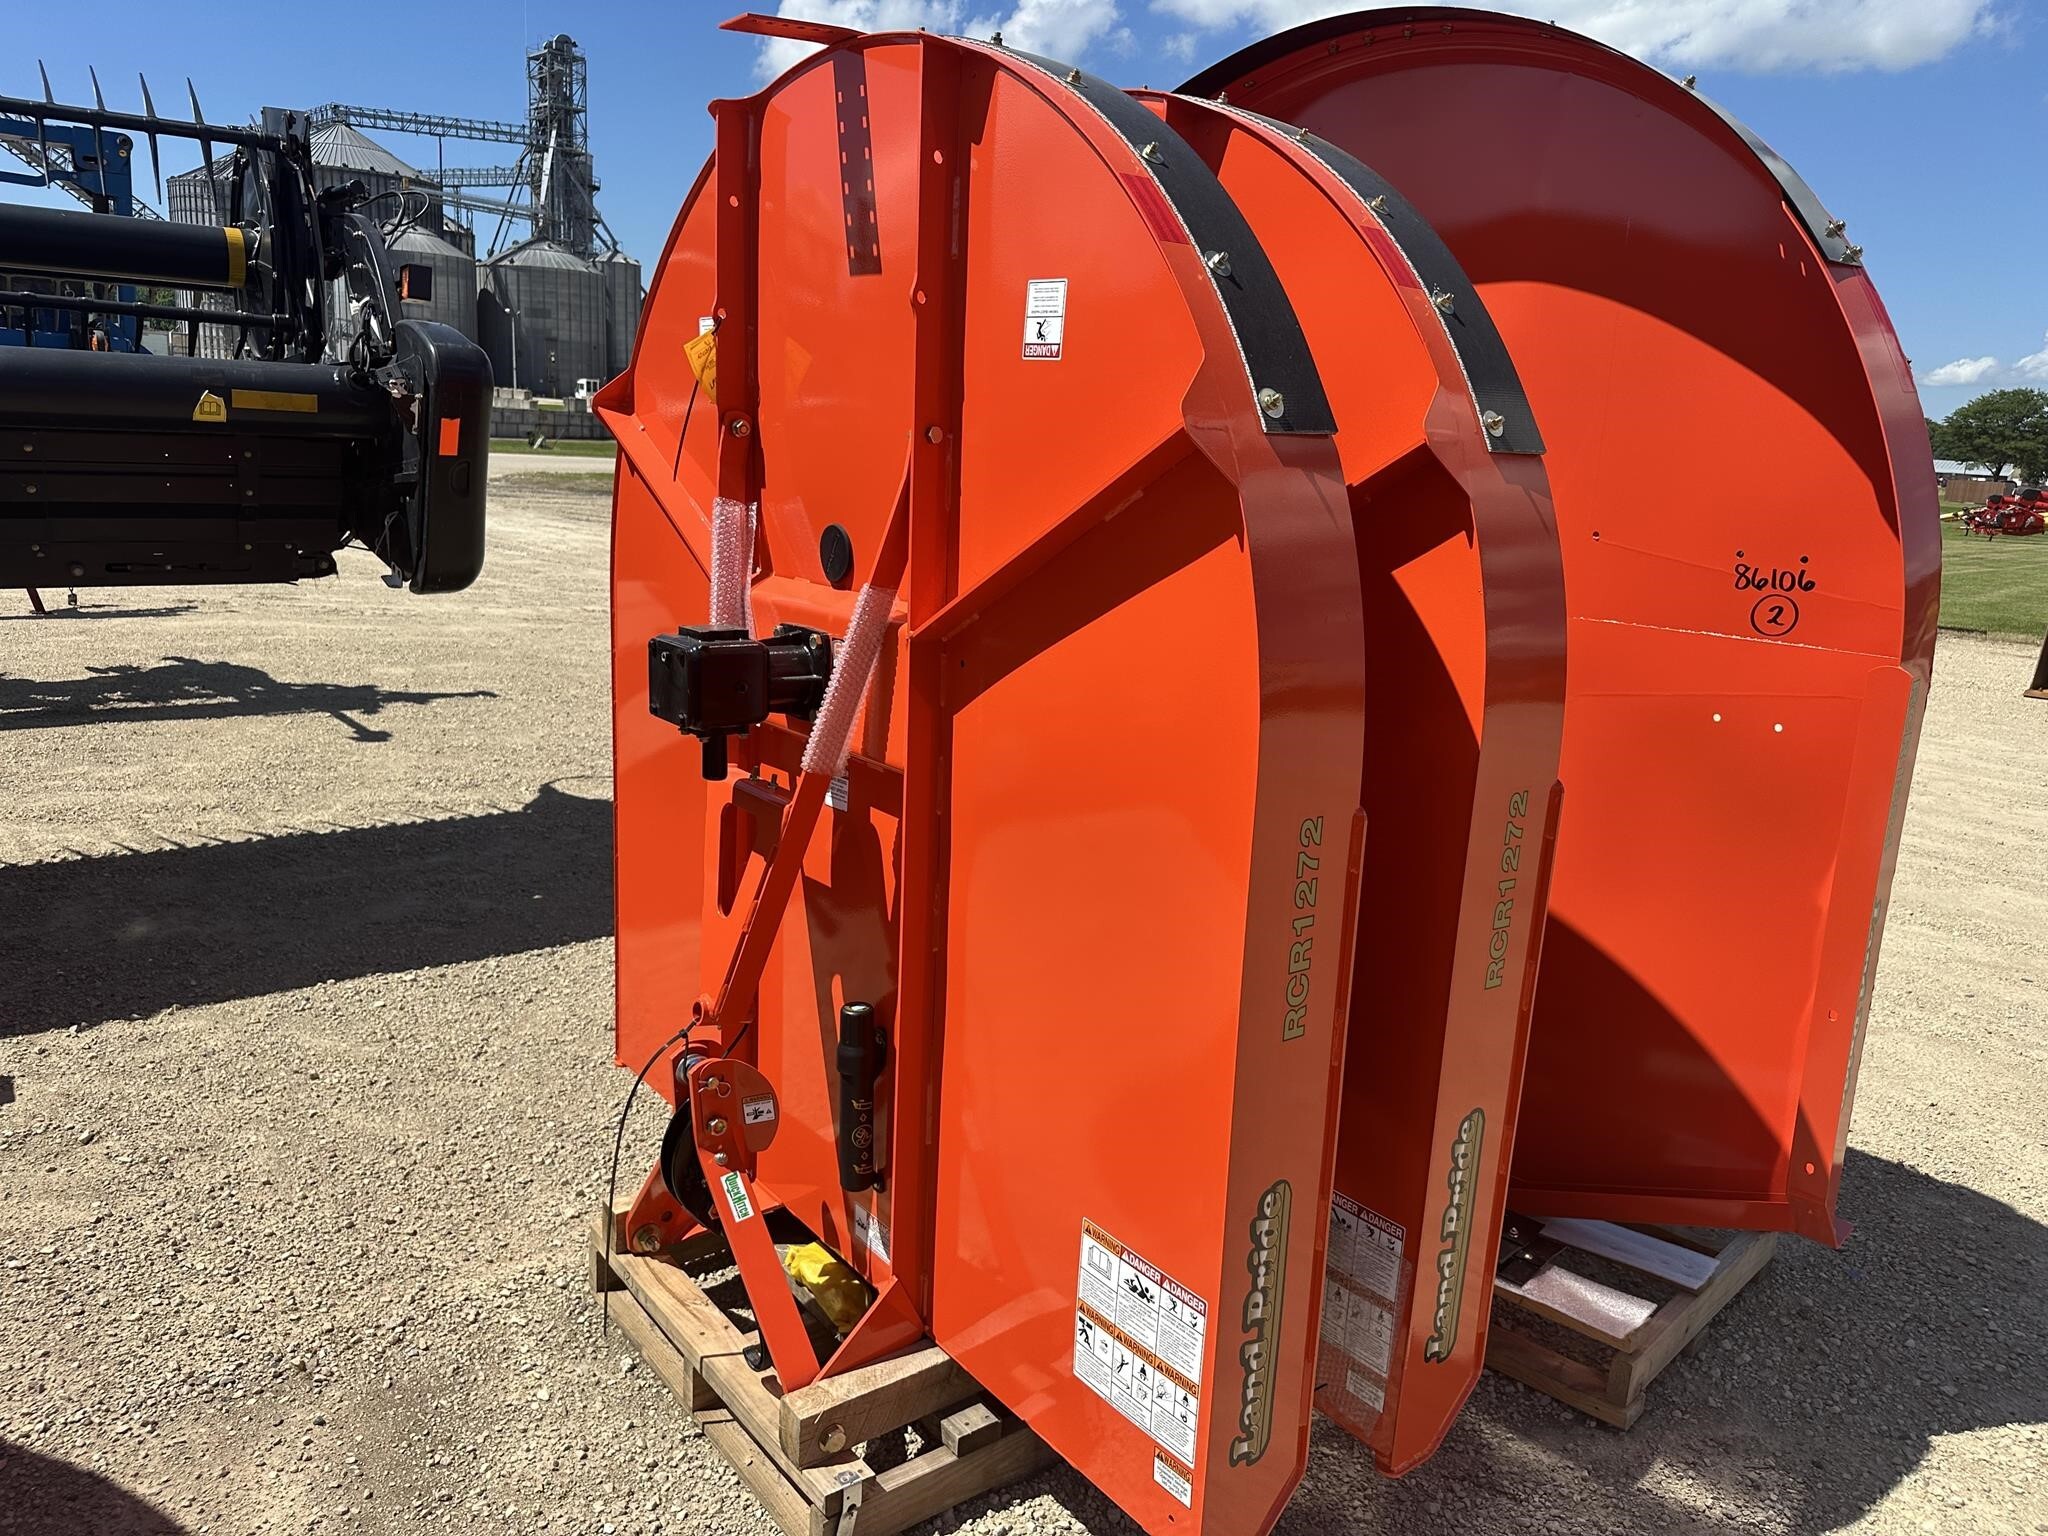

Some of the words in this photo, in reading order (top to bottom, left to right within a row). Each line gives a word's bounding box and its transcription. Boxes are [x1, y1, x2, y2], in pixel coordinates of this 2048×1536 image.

[1025, 345, 1051, 356] DANGER
[1735, 563, 1816, 592] 86106
[1767, 605, 1785, 626] 2
[1483, 789, 1529, 991] RCR1272
[1282, 815, 1324, 1042] RCR1272
[1441, 1118, 1475, 1240] Pride
[1333, 1193, 1358, 1215] ANGER
[1368, 1212, 1402, 1238] DANGER
[1092, 1229, 1121, 1255] WARNING
[1129, 1255, 1161, 1284] DANGER
[1245, 1190, 1282, 1330] Pride
[1170, 1282, 1205, 1313] DANGER
[1425, 1249, 1459, 1360] Land
[1085, 1307, 1114, 1334] WARNING
[1123, 1335, 1154, 1363] WARNING
[1164, 1365, 1197, 1395] WARNING
[1231, 1338, 1268, 1463] Land
[1164, 1456, 1190, 1482] WARNING
